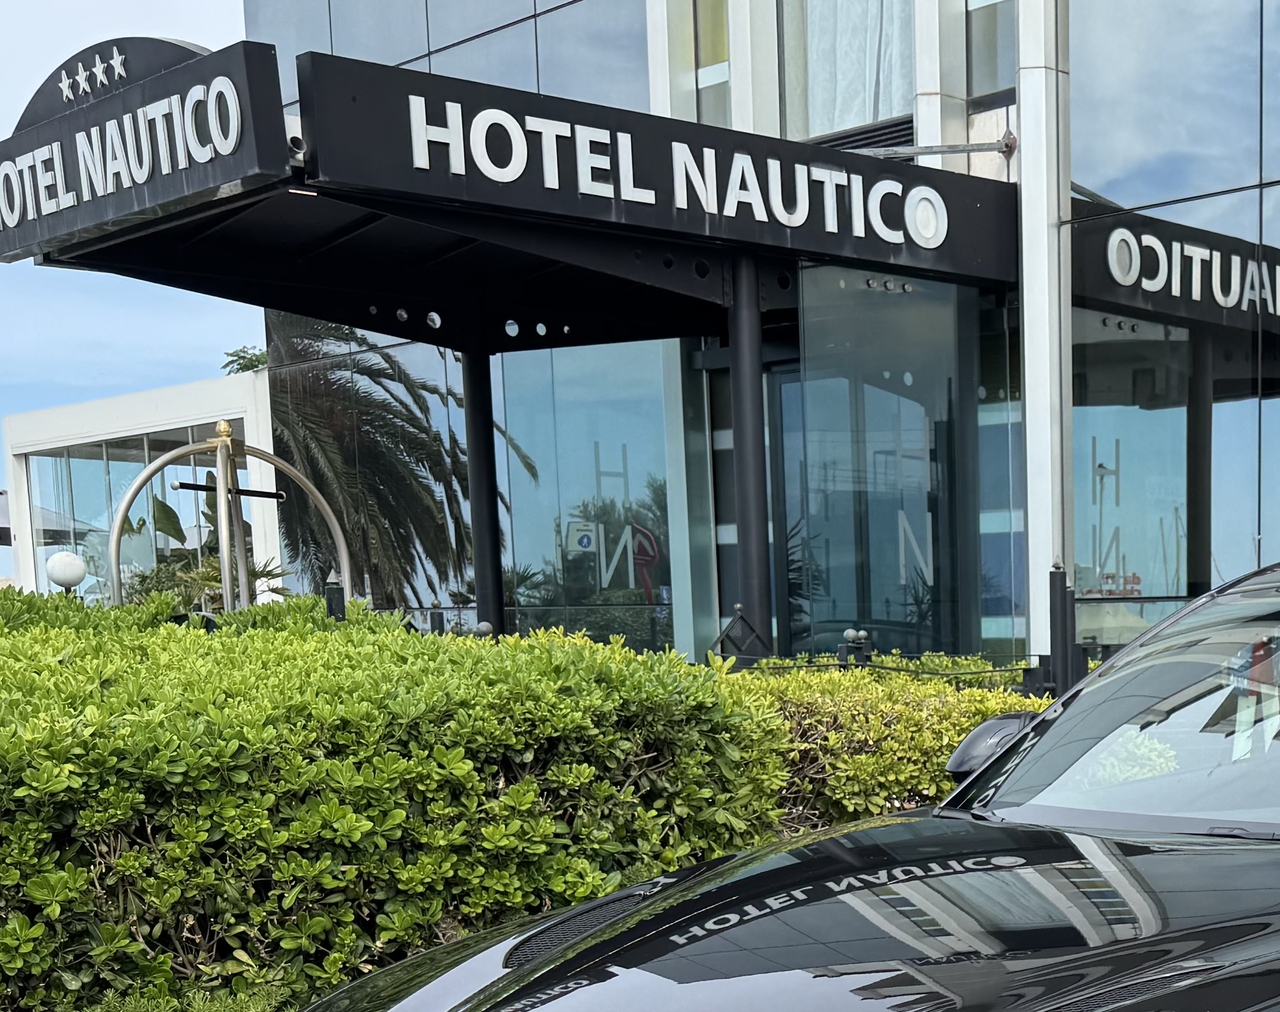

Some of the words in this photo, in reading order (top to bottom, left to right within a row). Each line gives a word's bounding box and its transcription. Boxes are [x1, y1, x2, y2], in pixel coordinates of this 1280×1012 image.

[0, 142, 77, 230] OTEL
[75, 75, 242, 202] NAUTICO
[408, 94, 656, 205] HOTEL
[671, 141, 949, 250] NAUTICO
